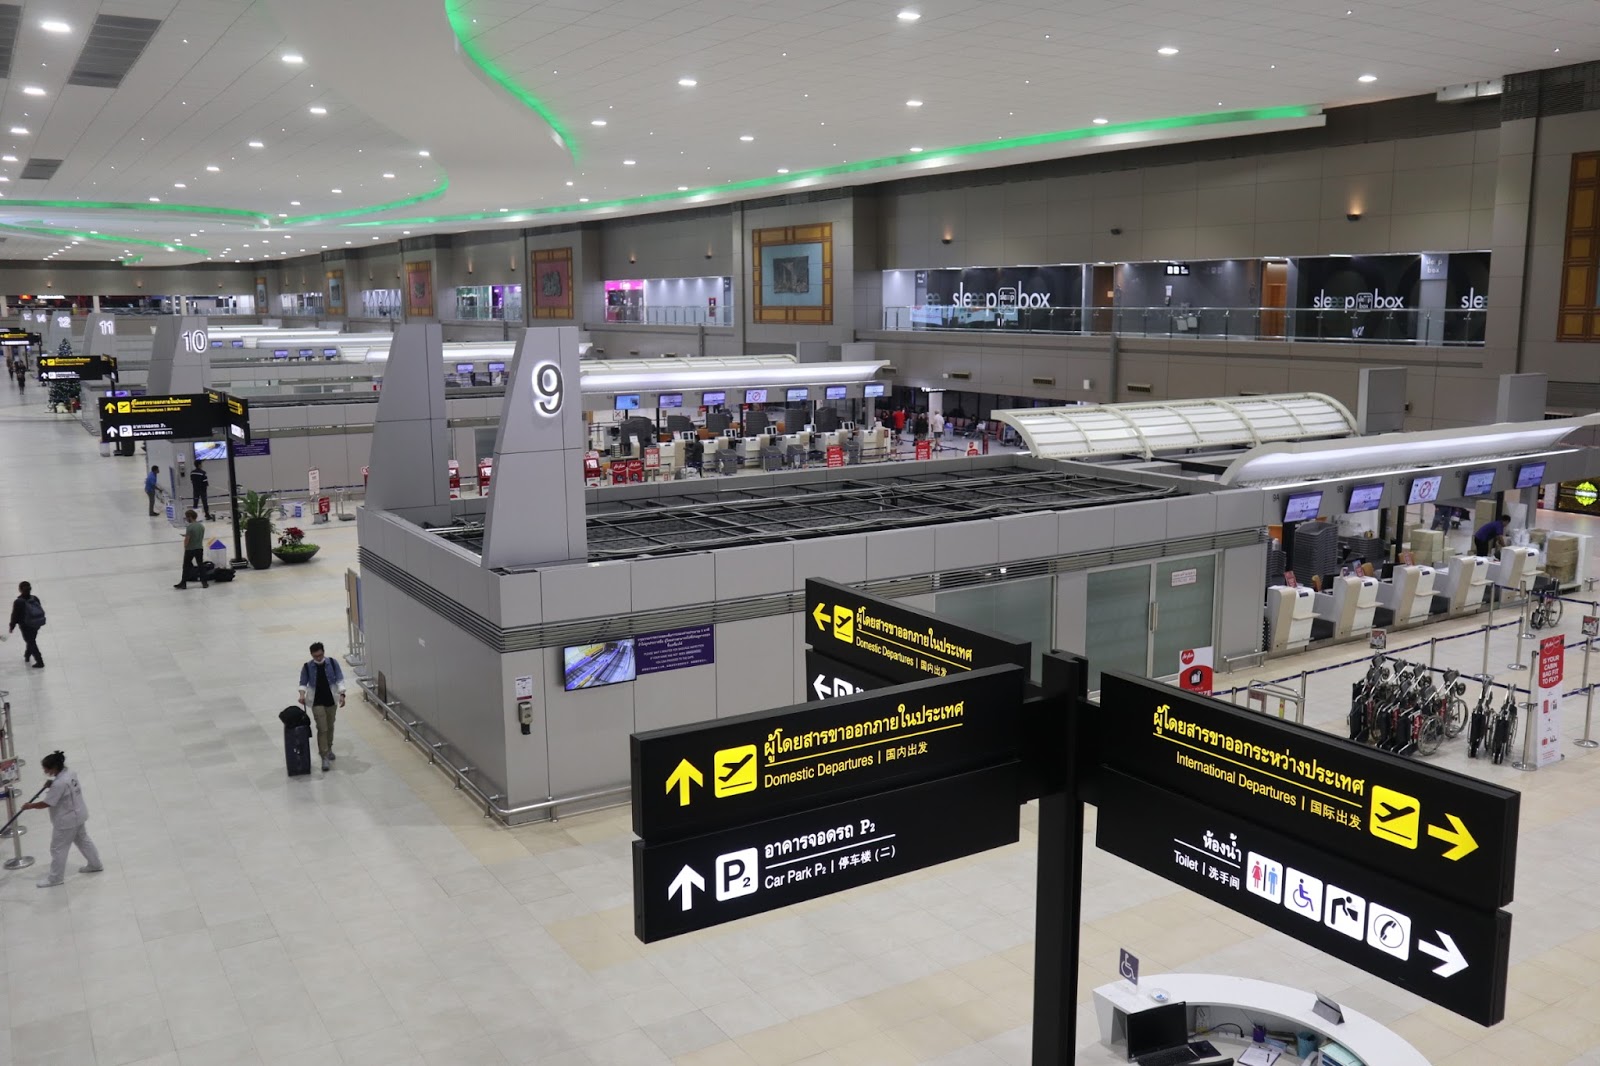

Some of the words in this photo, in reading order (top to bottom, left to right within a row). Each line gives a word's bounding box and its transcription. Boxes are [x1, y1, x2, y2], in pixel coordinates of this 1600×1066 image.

[1018, 281, 1051, 308] box
[1374, 288, 1404, 308] box
[57, 316, 71, 328] 12
[99, 320, 115, 335] 11
[182, 329, 207, 353] 10
[532, 361, 564, 418] 9
[1273, 494, 1279, 502] 9A
[856, 635, 881, 654] Domestic
[882, 646, 914, 667] Departures
[1544, 662, 1557, 670] CABIN
[1542, 670, 1551, 678] BAG
[763, 701, 964, 762] ผู้โดยสารขาออกภายในประเทศ
[764, 767, 815, 788] Domestic
[817, 754, 873, 778] Departures
[885, 741, 928, 762] 国内出发
[1152, 705, 1365, 797] ผู้โดยสารขาออกระหว่างประเทศ
[1176, 751, 1236, 784] International
[1238, 772, 1296, 807] Departures
[1310, 799, 1362, 831] 国际出发
[765, 822, 854, 858] อาคารจอดรถ
[1203, 830, 1242, 863] ห้องน้ำ
[765, 874, 785, 889] Car
[787, 866, 812, 885] Park
[838, 849, 872, 871] 停车楼
[1174, 850, 1198, 873] Toilet
[1208, 865, 1240, 890] 洗手间
